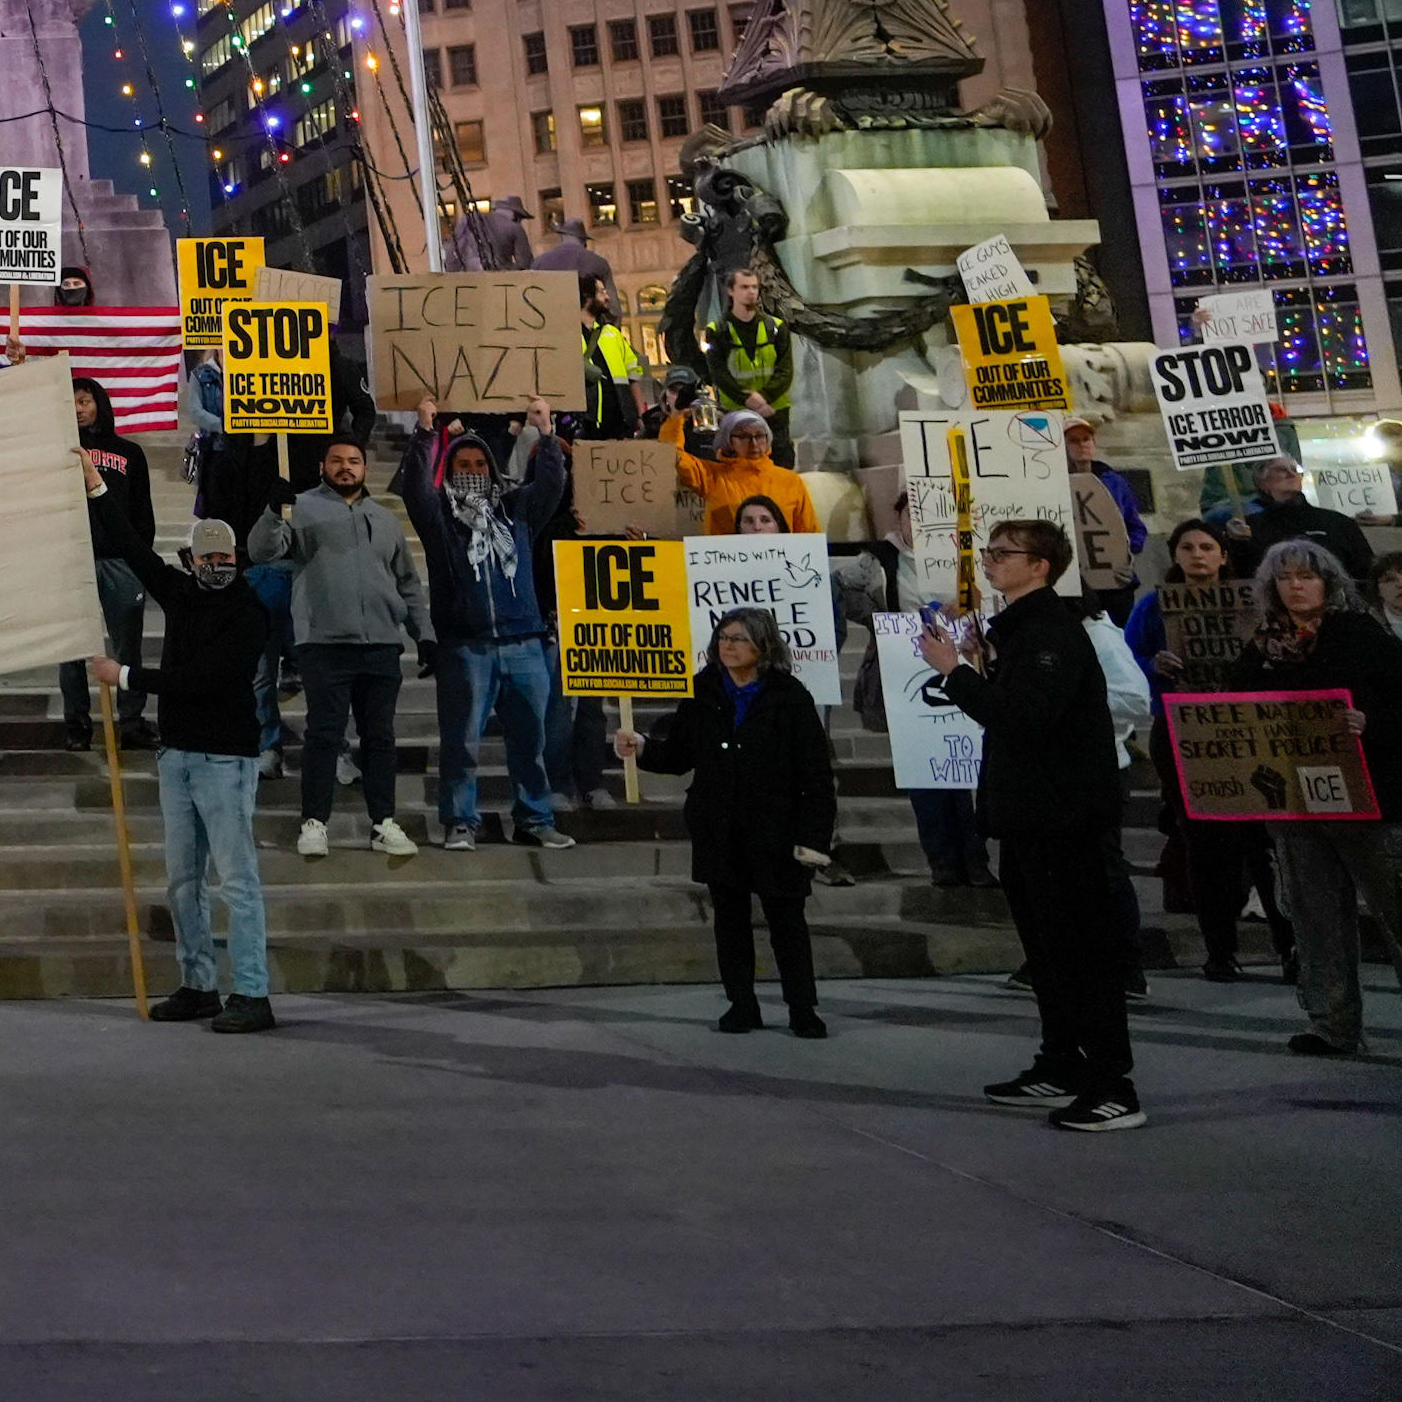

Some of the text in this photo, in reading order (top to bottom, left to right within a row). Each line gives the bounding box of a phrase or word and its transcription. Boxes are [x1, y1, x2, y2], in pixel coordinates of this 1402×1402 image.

[5, 230, 21, 248] OF
[22, 231, 47, 249] OUR
[976, 239, 1010, 264] GUYS
[196, 241, 247, 289] ICE
[380, 285, 546, 332] ICE IS
[228, 308, 323, 359] STOP
[973, 302, 1036, 356] ICE
[1203, 313, 1276, 338] NOT SAFE
[390, 339, 566, 403] NAZI
[976, 360, 1051, 384] OUT OF OUR
[1155, 345, 1252, 402] STOP
[229, 372, 326, 396] ICE TERROR
[973, 378, 1064, 404] COMMUNITIES
[230, 398, 327, 415] NOW!
[1168, 404, 1268, 436] ICE TERROR
[1174, 427, 1272, 453] NOW!
[1318, 469, 1384, 487] ABOLISH
[1339, 487, 1378, 507] ICE
[979, 502, 1064, 526] people not
[689, 548, 787, 565] I STAND WITH
[583, 545, 660, 611] ICE
[693, 578, 785, 607] RENEE
[1162, 585, 1256, 610] HANDS
[574, 623, 673, 648] OUT OF OUR
[875, 613, 918, 635] IT'S
[566, 648, 687, 675] COMMUNITIES
[569, 677, 687, 691] PARTY FOR SOCIALISM & LIBERATION
[1178, 703, 1247, 725] FREE
[943, 734, 975, 759] TO
[1177, 733, 1348, 760] SECRET POLICE
[1305, 774, 1345, 802] ICE
